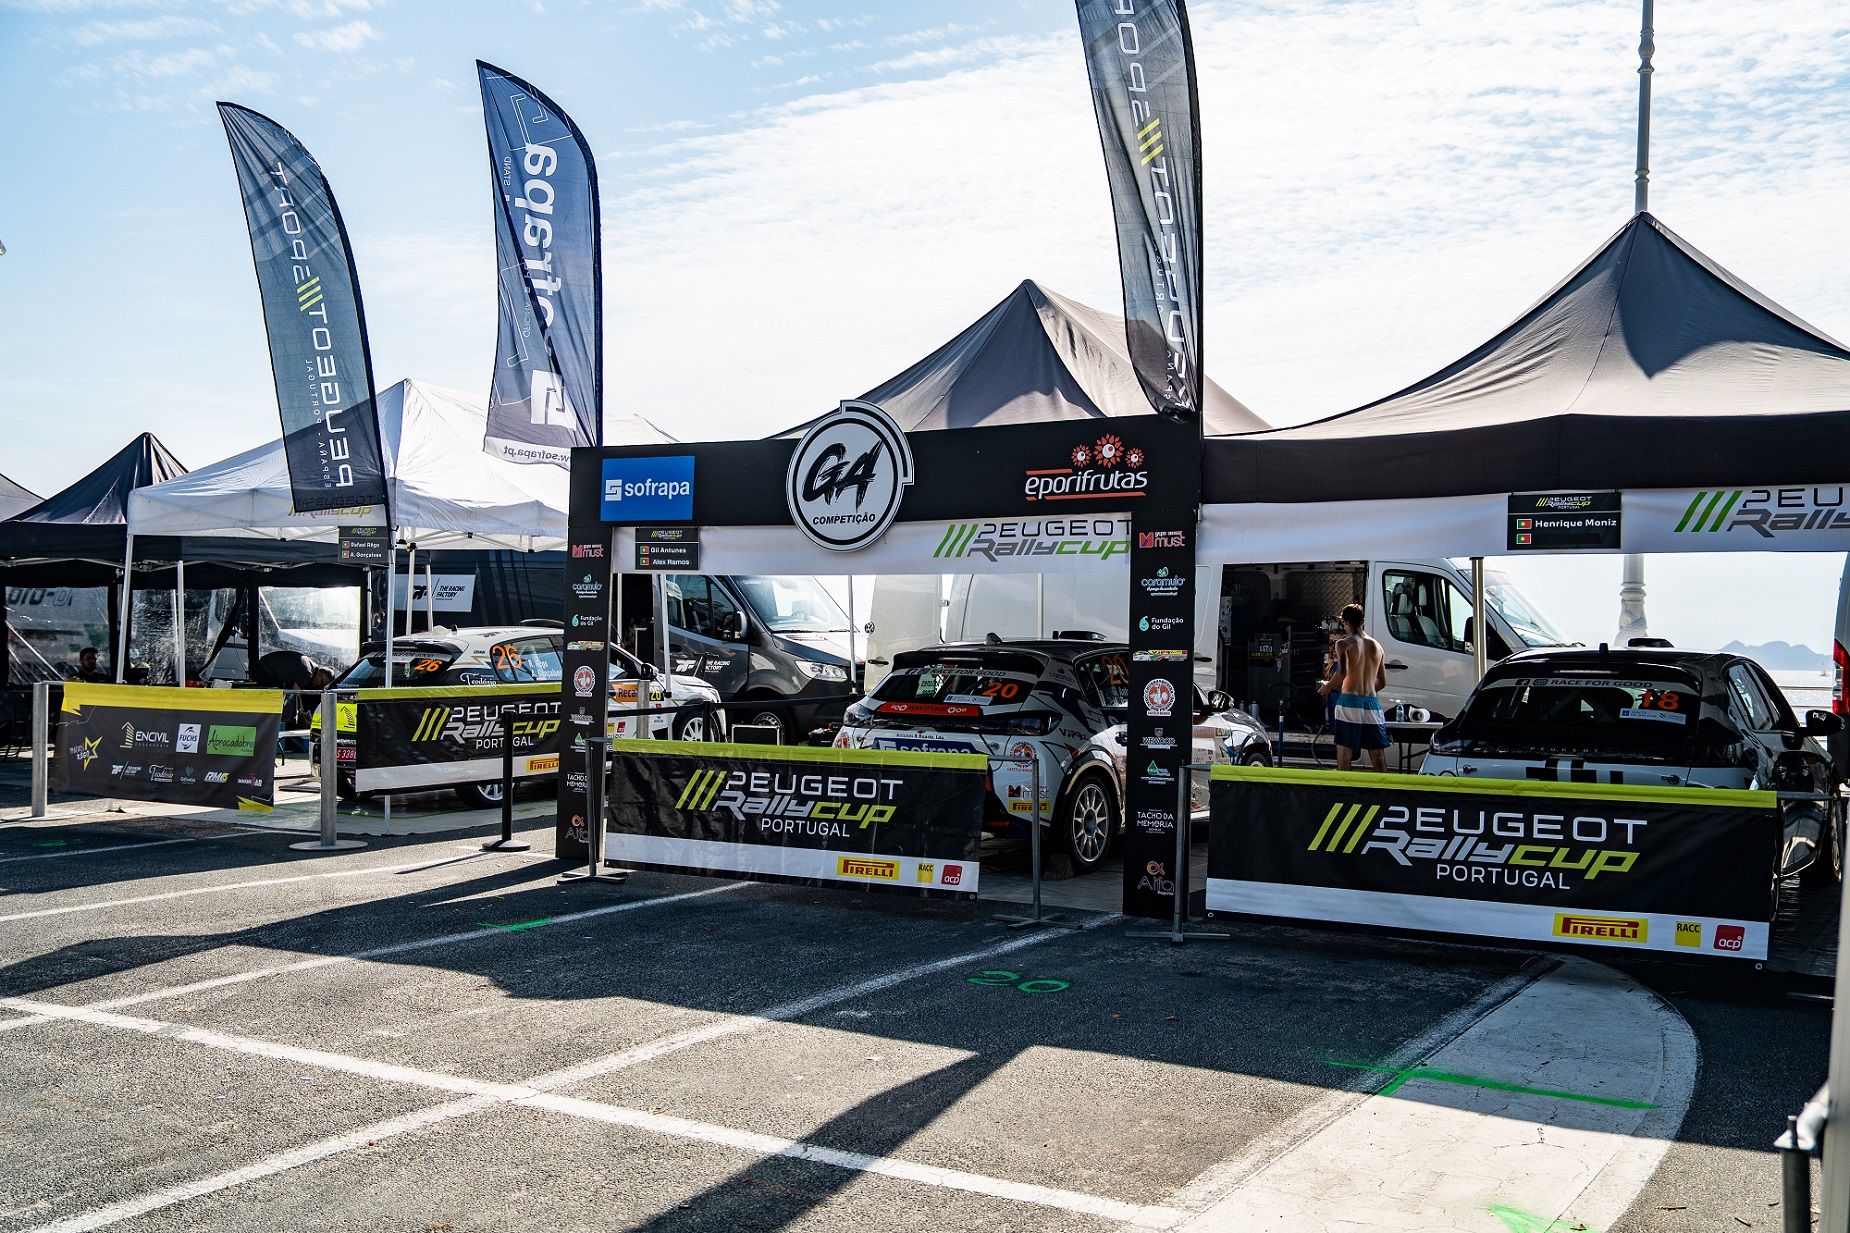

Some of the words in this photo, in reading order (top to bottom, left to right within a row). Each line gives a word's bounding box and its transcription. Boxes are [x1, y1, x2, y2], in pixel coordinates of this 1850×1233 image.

[802, 439, 886, 511] GA
[624, 478, 690, 500] sofrapa
[1024, 469, 1148, 499] eporifrutas
[1742, 487, 1844, 509] PEU
[812, 512, 876, 526] COMPETIÇÃO
[1535, 519, 1583, 529] Henrique
[1585, 518, 1617, 527] Moniz
[1725, 508, 1850, 538] Rally
[977, 520, 1131, 539] PEUGEOT
[1154, 535, 1186, 548] must
[582, 547, 604, 557] must
[1151, 617, 1184, 625] Fundação
[492, 645, 523, 669] 26
[414, 659, 443, 672] 26
[1101, 655, 1129, 685] 20
[617, 688, 638, 698] Reca
[650, 686, 662, 700] 26
[982, 681, 1019, 699] 20
[1638, 691, 1679, 711] 18
[135, 731, 170, 743] ENCIVIL
[179, 734, 198, 742] FUCHS
[476, 736, 534, 750] PORTGAL
[530, 758, 559, 770] PIRELLI
[566, 773, 583, 781] TACHO
[725, 770, 903, 800] PEUGEOT
[1022, 789, 1050, 799] mst
[1012, 803, 1048, 811] PIRELI
[1137, 811, 1163, 820] TACHO
[1163, 812, 1174, 820] DA
[761, 818, 850, 837] PORTUGAL
[1379, 805, 1648, 844] PEUGEOT
[843, 859, 894, 878] PIRELLI
[918, 863, 934, 872] RACC
[944, 873, 962, 884] acp
[1136, 876, 1175, 892] Alfa
[1437, 864, 1571, 890] PORTUGAL
[1561, 917, 1639, 940] PIRELLI
[1676, 922, 1700, 934] RACC
[1718, 935, 1741, 951] acp
